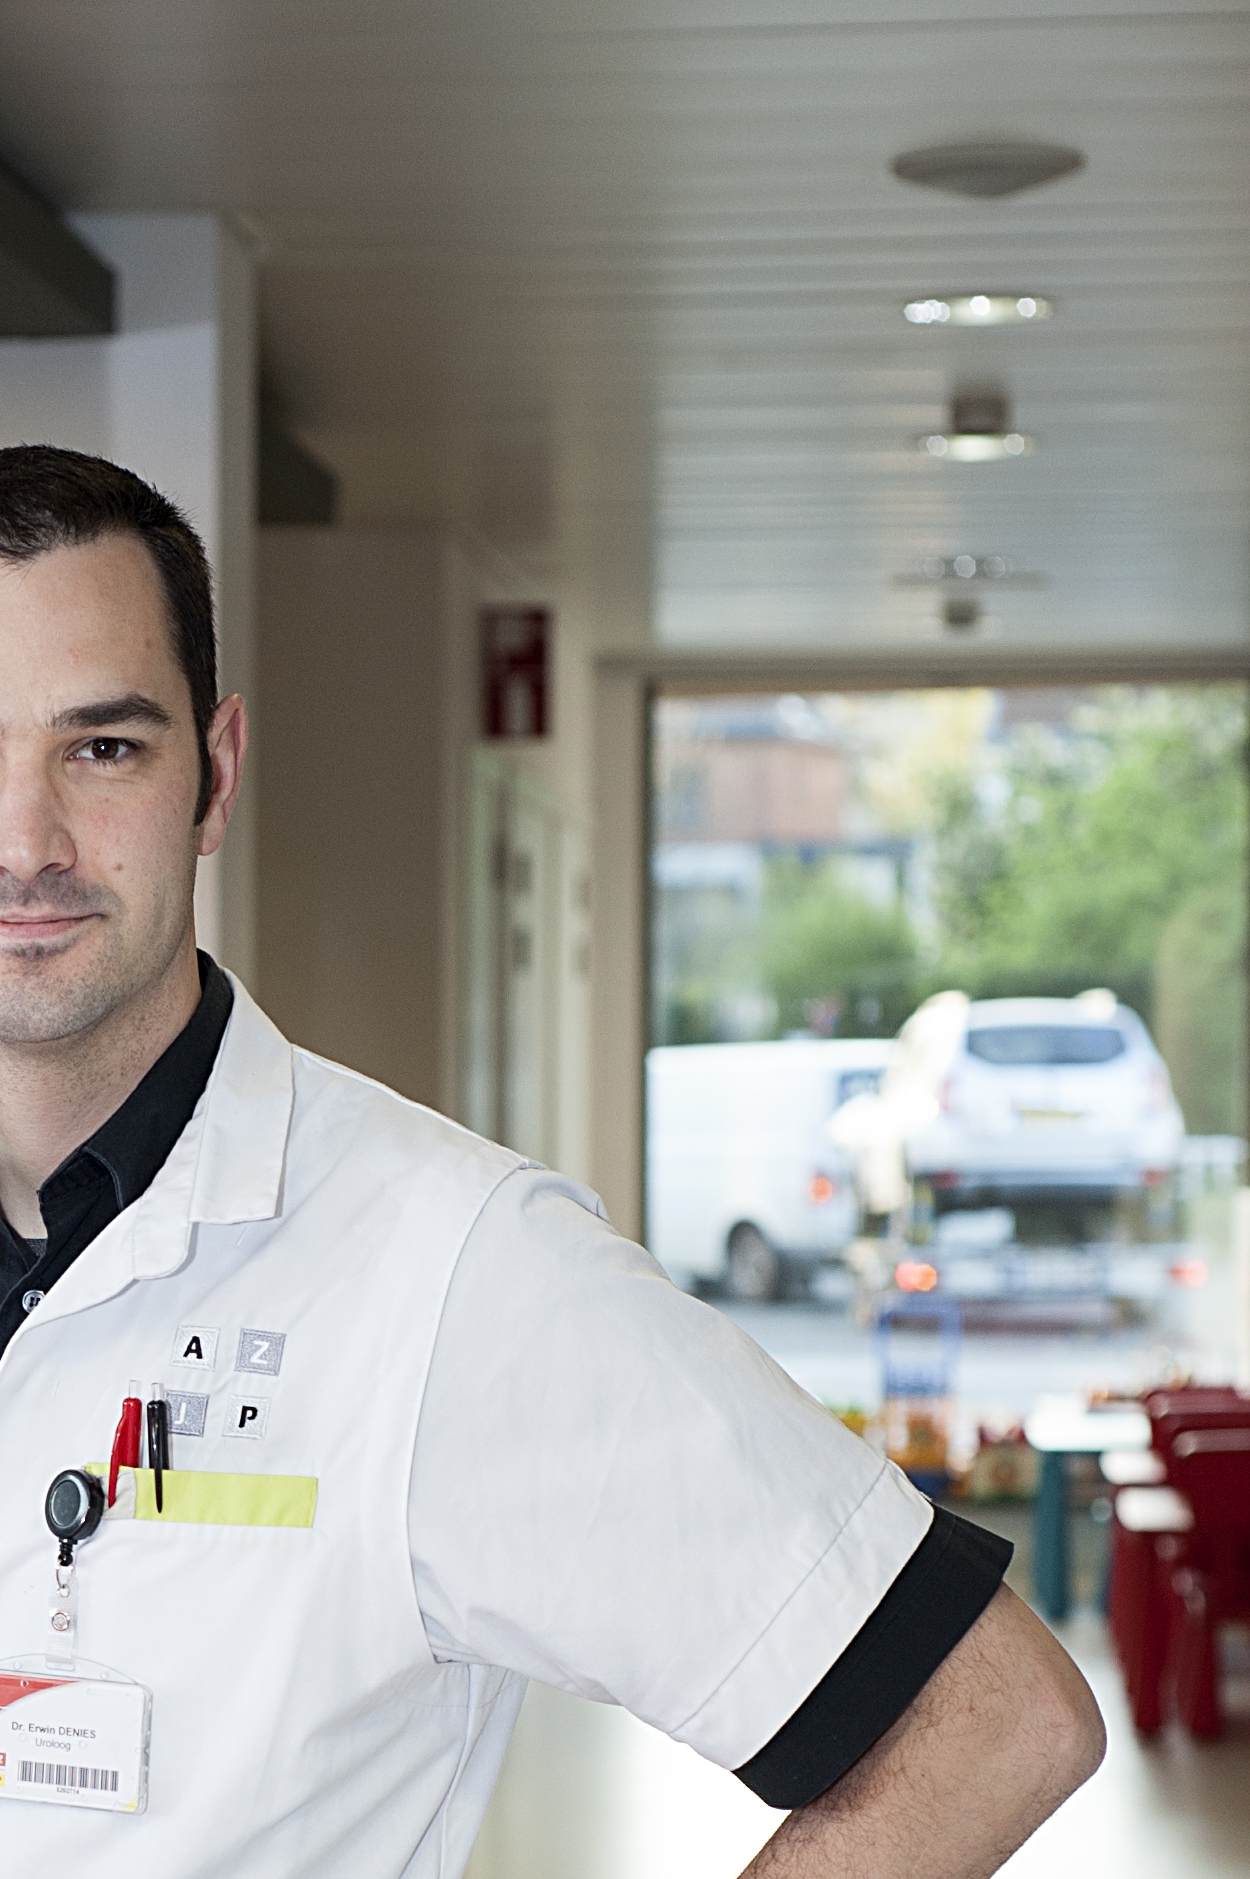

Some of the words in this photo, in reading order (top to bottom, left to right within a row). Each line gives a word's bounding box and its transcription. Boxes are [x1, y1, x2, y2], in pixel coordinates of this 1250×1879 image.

[183, 1336, 203, 1360] A
[250, 1340, 270, 1364] Z
[174, 1402, 187, 1425] J
[238, 1405, 258, 1428] P
[11, 1721, 25, 1732] Dr.
[28, 1723, 56, 1735] Erwin
[58, 1726, 96, 1739] DENIES
[35, 1737, 71, 1752] Uroloog
